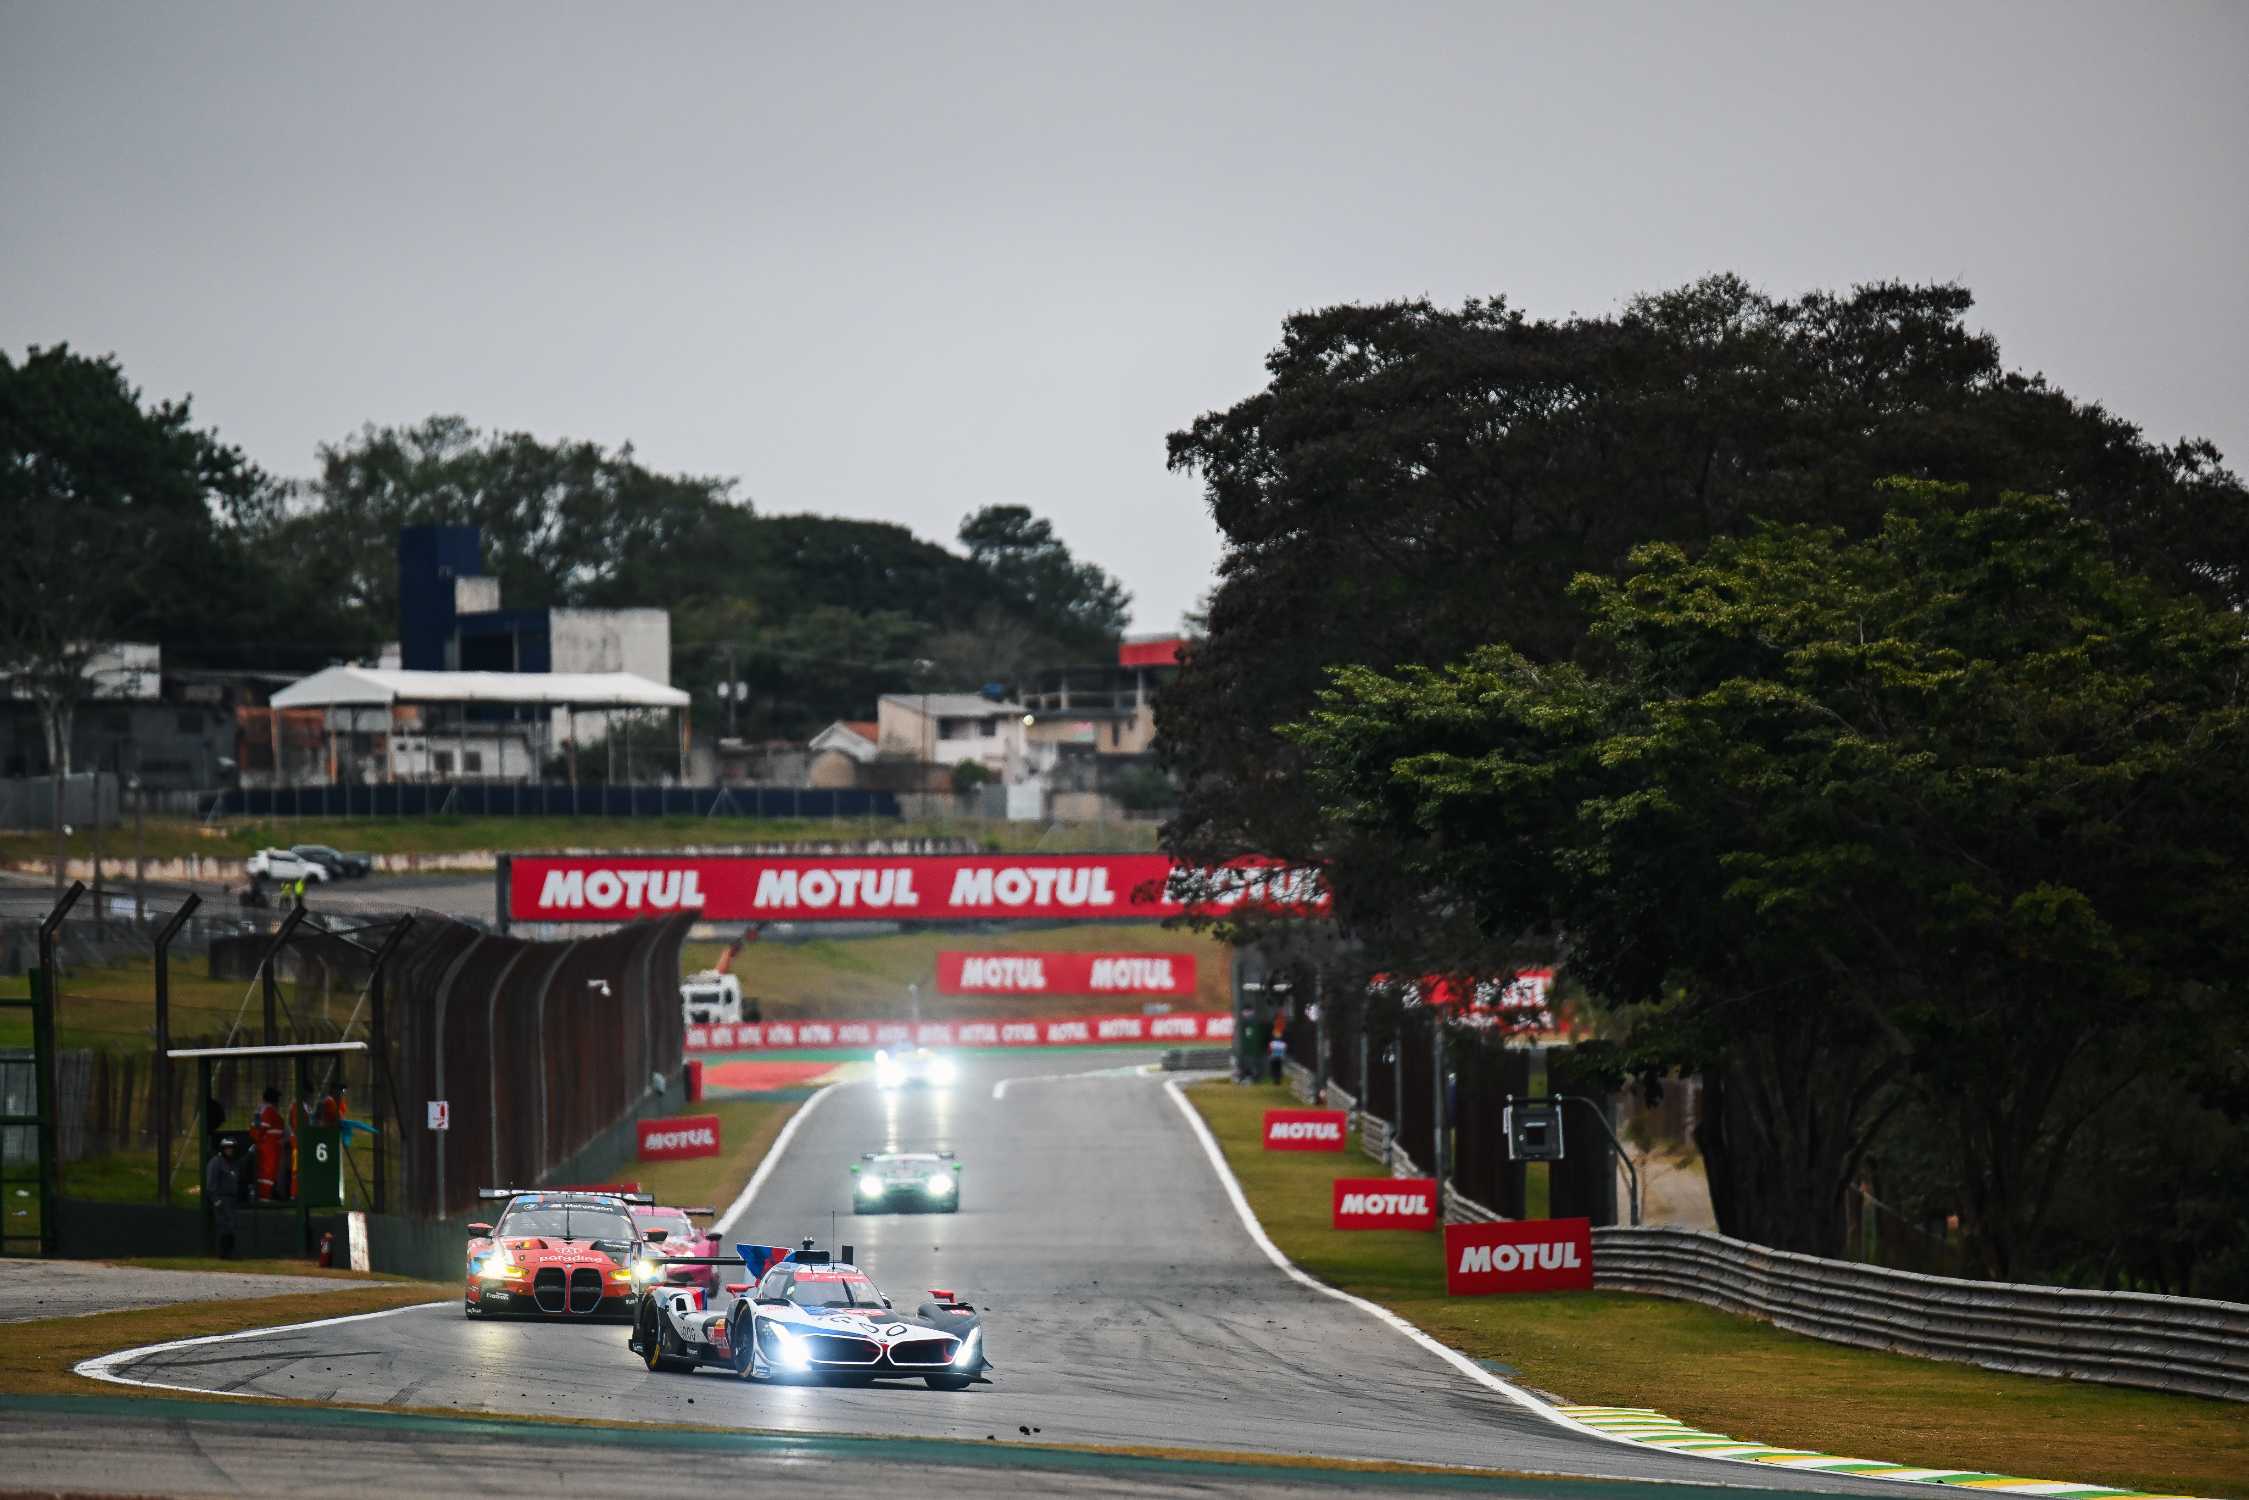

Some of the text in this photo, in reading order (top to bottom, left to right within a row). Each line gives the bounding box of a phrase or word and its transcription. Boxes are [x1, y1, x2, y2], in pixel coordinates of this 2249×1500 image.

[538, 869, 705, 909] MOTUL
[753, 868, 919, 908] MOTUL
[948, 867, 1115, 906] MOTUL
[961, 957, 1175, 989] MOTUL MOTUL
[645, 1128, 715, 1150] MOTUL
[1270, 1122, 1341, 1139] MOTUL
[316, 1143, 328, 1161] 6
[1340, 1194, 1429, 1215] MOTUL
[1459, 1242, 1581, 1273] MOTUL
